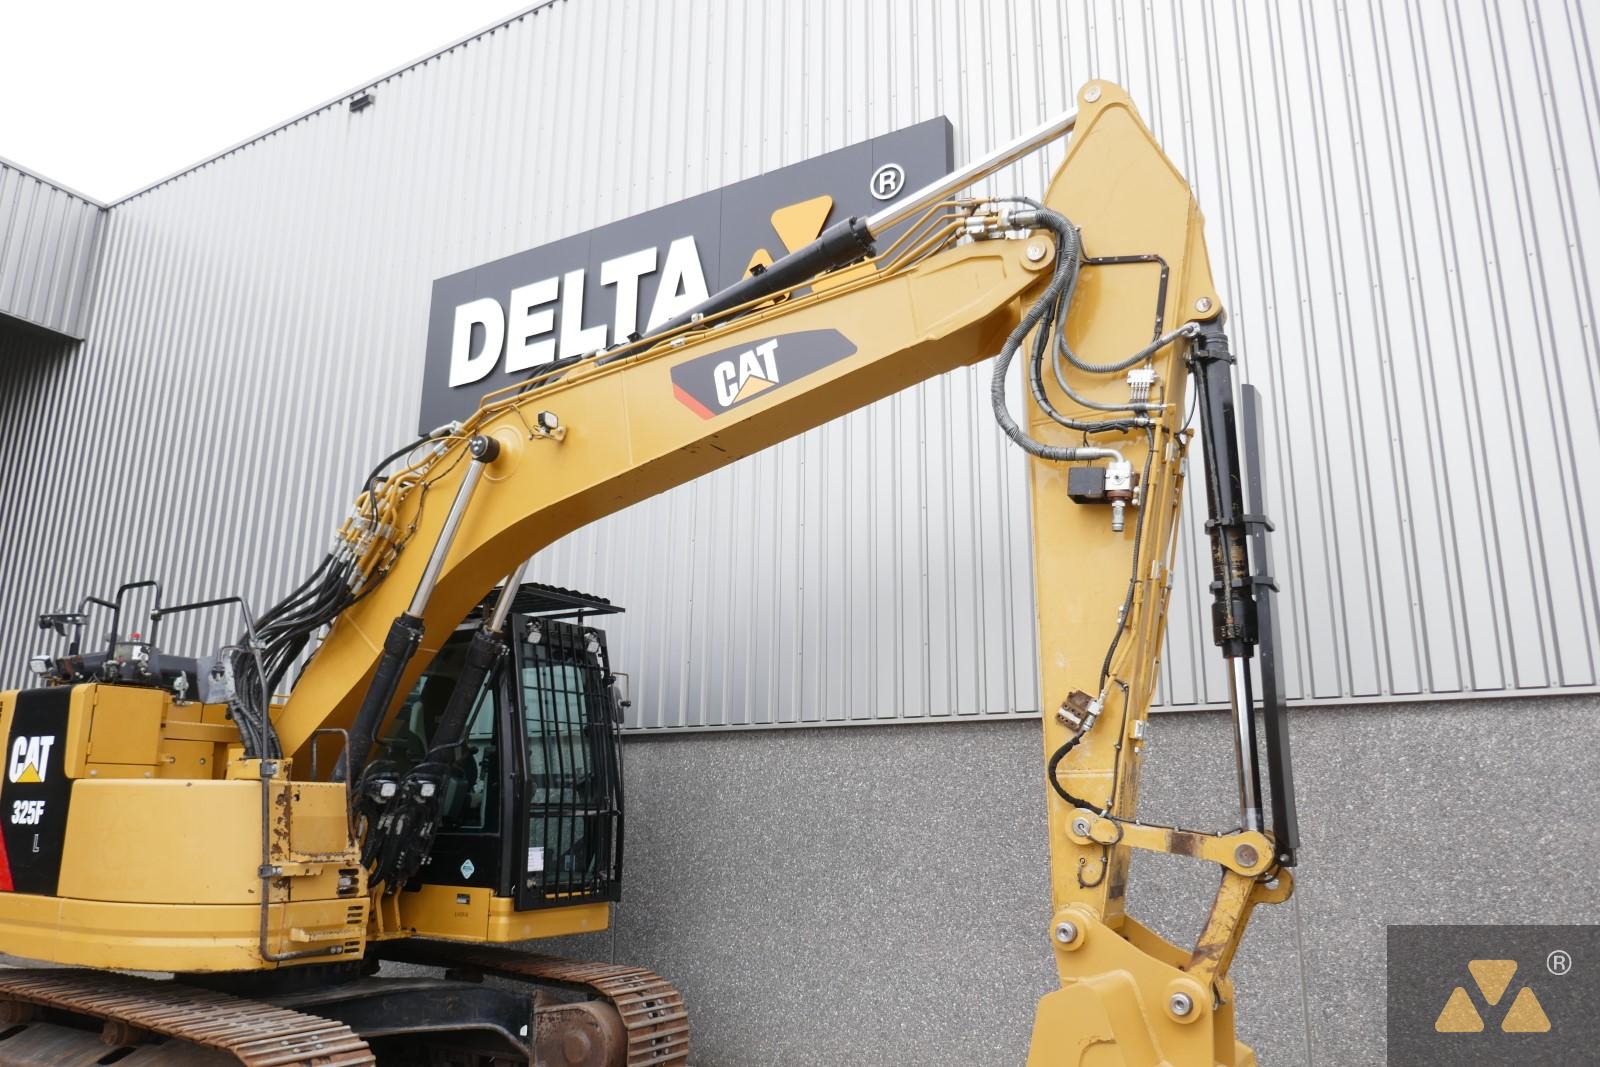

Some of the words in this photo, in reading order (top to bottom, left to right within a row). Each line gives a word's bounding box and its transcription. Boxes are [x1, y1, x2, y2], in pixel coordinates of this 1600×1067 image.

[448, 235, 710, 388] DELTA
[713, 338, 779, 407] CAT
[9, 735, 55, 783] CAT
[11, 800, 45, 825] 325F
